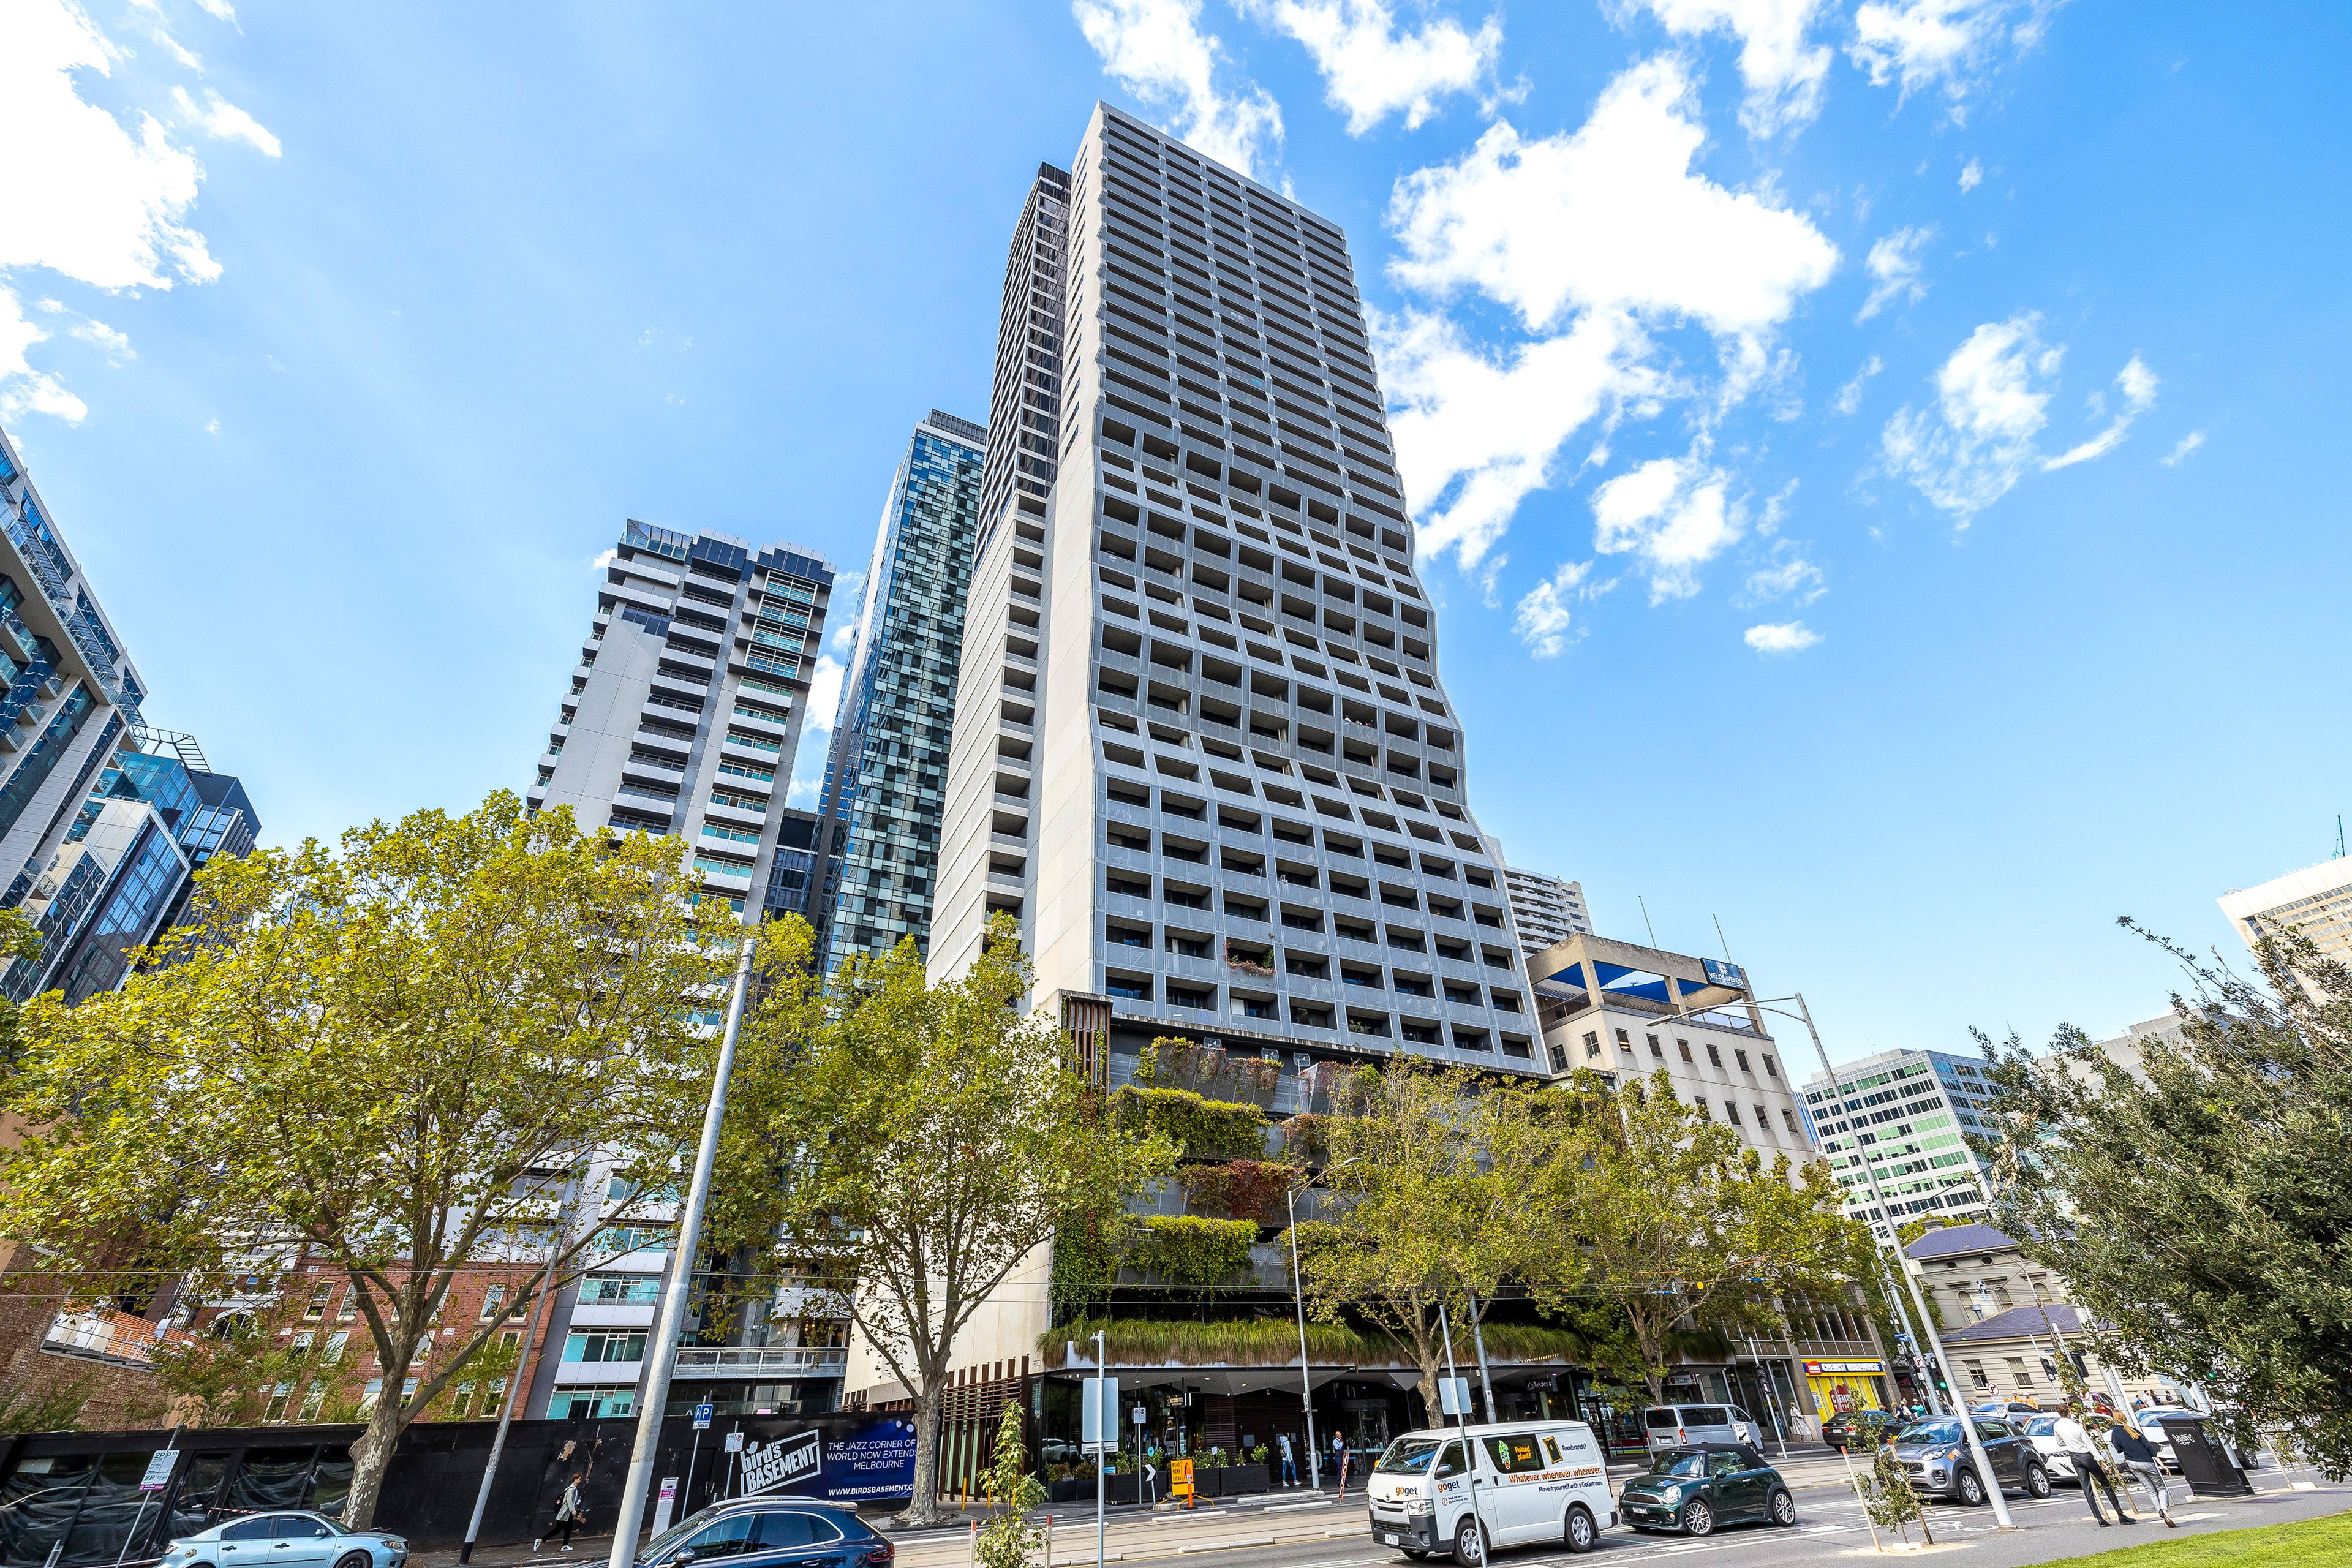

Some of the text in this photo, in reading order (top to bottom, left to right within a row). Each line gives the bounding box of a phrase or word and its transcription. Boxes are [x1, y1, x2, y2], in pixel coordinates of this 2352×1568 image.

[1708, 972, 1725, 981] VELOS
[1820, 1363, 1847, 1371] CHEMIST
[1845, 1363, 1880, 1371] WAREHOUSE
[702, 1408, 709, 1419] P
[846, 1441, 867, 1450] JAZZ
[869, 1440, 903, 1449] CORNER
[740, 1442, 782, 1473] bird's
[827, 1452, 858, 1461] WORLD
[1517, 1452, 1532, 1461] plant?
[746, 1441, 819, 1493] BASEMENT
[854, 1460, 905, 1470] MELBOURNE
[1509, 1467, 1602, 1483] Whatever, whenever, wherever.
[1396, 1487, 1418, 1496] goget
[1438, 1480, 1460, 1493] goget
[1553, 1483, 1569, 1492] yourself
